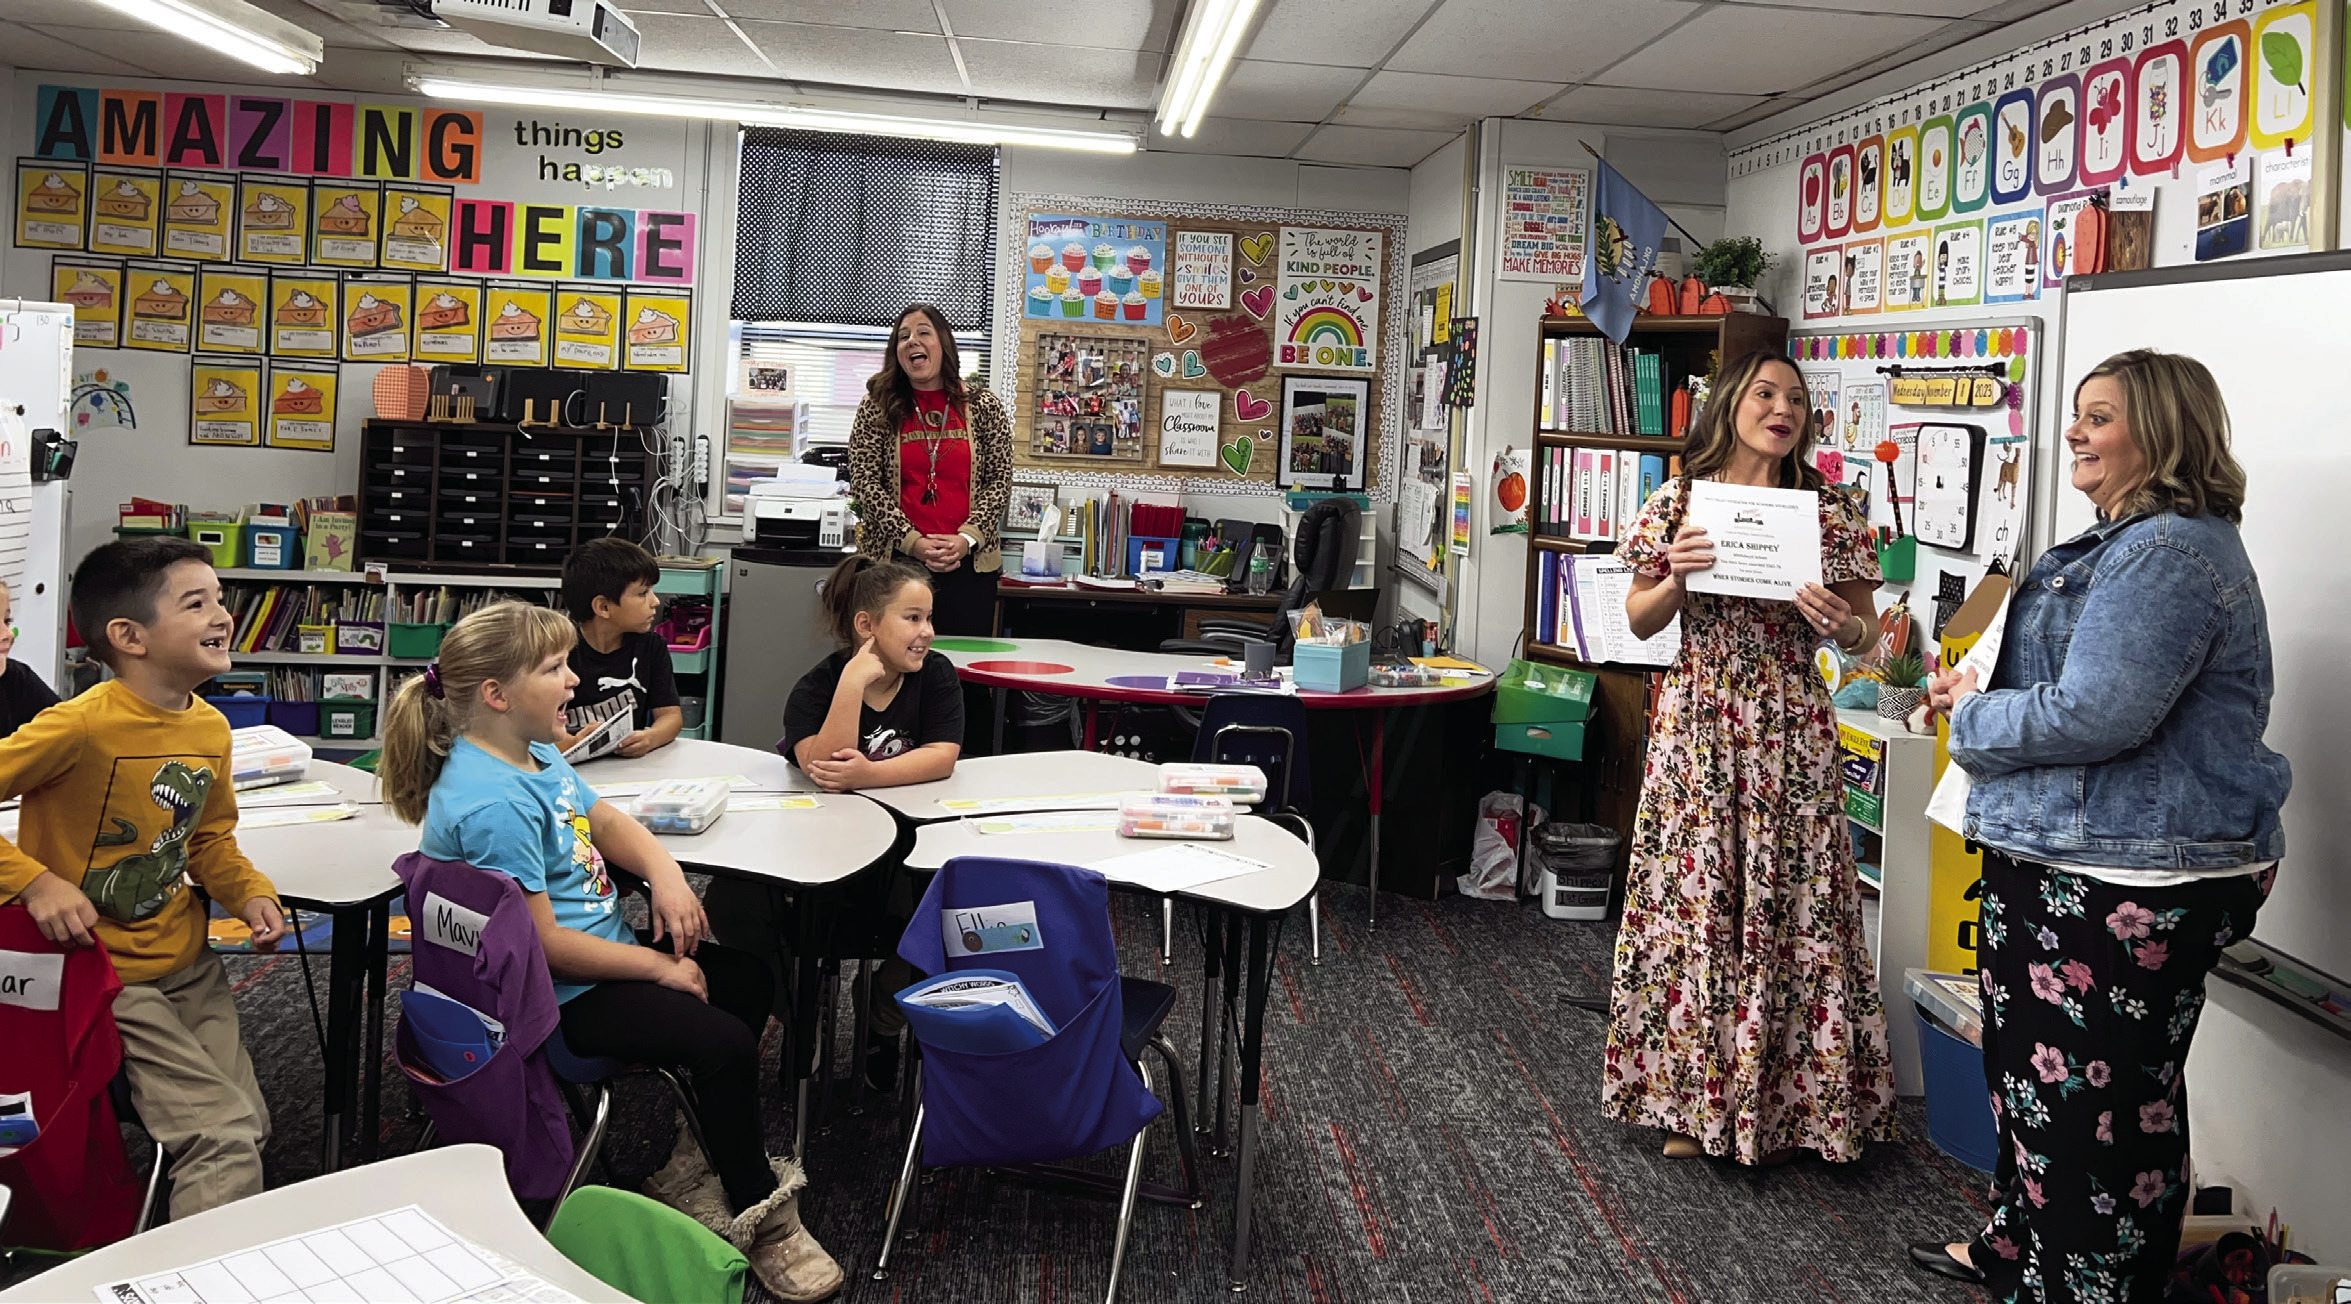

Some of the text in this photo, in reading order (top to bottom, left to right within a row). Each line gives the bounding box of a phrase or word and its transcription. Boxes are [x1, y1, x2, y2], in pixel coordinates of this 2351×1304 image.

[1888, 114, 1895, 129] 16
[1902, 109, 1909, 124] 17
[1915, 105, 1922, 120] 18
[1929, 100, 1936, 116] 19
[1943, 95, 1950, 111] 20
[1957, 89, 1965, 106] 21
[1972, 84, 1981, 101] 22
[1988, 78, 1997, 95] 23
[2004, 71, 2014, 90] 24
[2025, 64, 2035, 82] 25
[2043, 61, 2053, 77] 26
[2061, 53, 2072, 71] 27
[2080, 46, 2091, 64] 28
[2101, 39, 2112, 59] 29
[2121, 32, 2133, 52] 30
[2142, 24, 2153, 46] 31
[2165, 18, 2178, 37] 32
[2189, 9, 2202, 31] 33
[2214, 2, 2227, 22] 34
[2273, 90, 2291, 118] Ll
[2205, 109, 2227, 134] Kk
[37, 90, 475, 180] AMAZING
[514, 120, 624, 154] things
[2147, 123, 2165, 157] Jj
[2099, 137, 2108, 160] Ii
[2047, 150, 2064, 171] Hh
[2265, 154, 2309, 174] characterist
[539, 156, 673, 190] happen
[1964, 170, 1978, 190] Ff
[2003, 160, 2020, 189] Gg
[2209, 168, 2238, 186] mammal
[1892, 189, 1905, 208] Dd
[1927, 180, 1940, 200] Ee
[1833, 203, 1844, 220] Bb
[1861, 196, 1873, 213] Cc
[1806, 210, 1816, 226] Aa
[457, 202, 685, 279] HERE
[1092, 222, 1163, 241] BIRTHDAY
[1179, 234, 1185, 242] IF
[1213, 236, 1228, 245] SEE
[1299, 232, 1359, 247] The world
[1180, 244, 1226, 254] SOMEONE
[1306, 247, 1355, 261] is full of
[1511, 241, 1554, 250] DREAM BIG
[1177, 253, 1220, 263] WITHOUT
[1503, 257, 1581, 275] MAKE MEMORIES
[1287, 261, 1375, 277] KIND PEOPLE.
[1177, 275, 1228, 284] GIVE THEM
[1185, 284, 1219, 293] ONE OF
[1179, 292, 1224, 305] YOURS
[1293, 303, 1309, 317] you
[1310, 294, 1335, 307] can't
[1337, 297, 1361, 317] find
[1280, 345, 1310, 363] BE
[1195, 394, 1212, 409] love
[1895, 384, 1926, 401] Wednesday
[1926, 386, 1952, 397] November
[1975, 384, 1992, 398] 2023
[1164, 415, 1215, 433] Classroom
[1165, 442, 1188, 455] share
[1996, 520, 2008, 541] ch
[1721, 541, 1779, 552] ERICA SHIPPEY
[1558, 873, 1606, 887] Shippey
